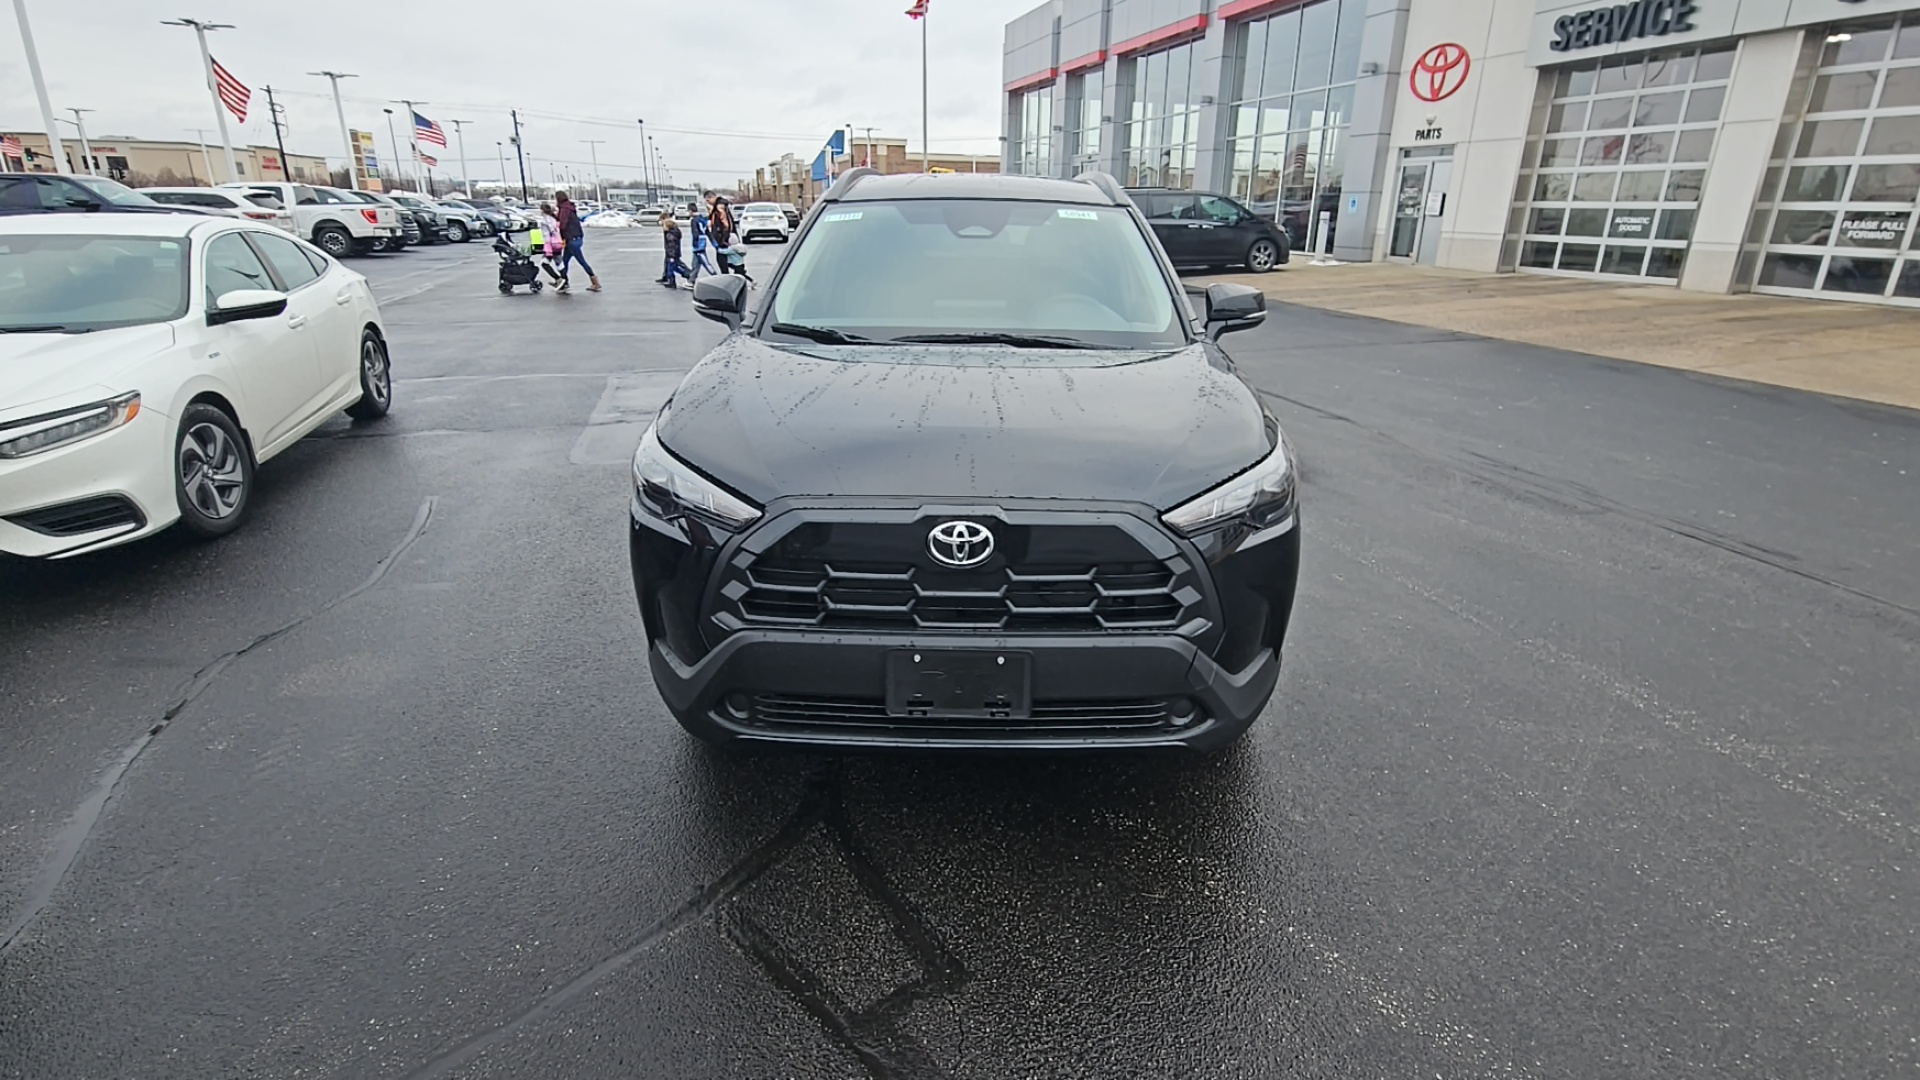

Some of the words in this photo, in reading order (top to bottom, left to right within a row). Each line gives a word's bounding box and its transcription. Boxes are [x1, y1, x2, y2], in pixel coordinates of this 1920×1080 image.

[1550, 0, 1698, 51] SERVICE
[1415, 127, 1443, 141] PARTS
[1614, 216, 1651, 225] AUTOMATIC
[1842, 220, 1879, 231] PLEASE
[1881, 220, 1906, 231] PULL
[1618, 224, 1642, 232] DOORS
[1847, 229, 1896, 240] FORWARD
